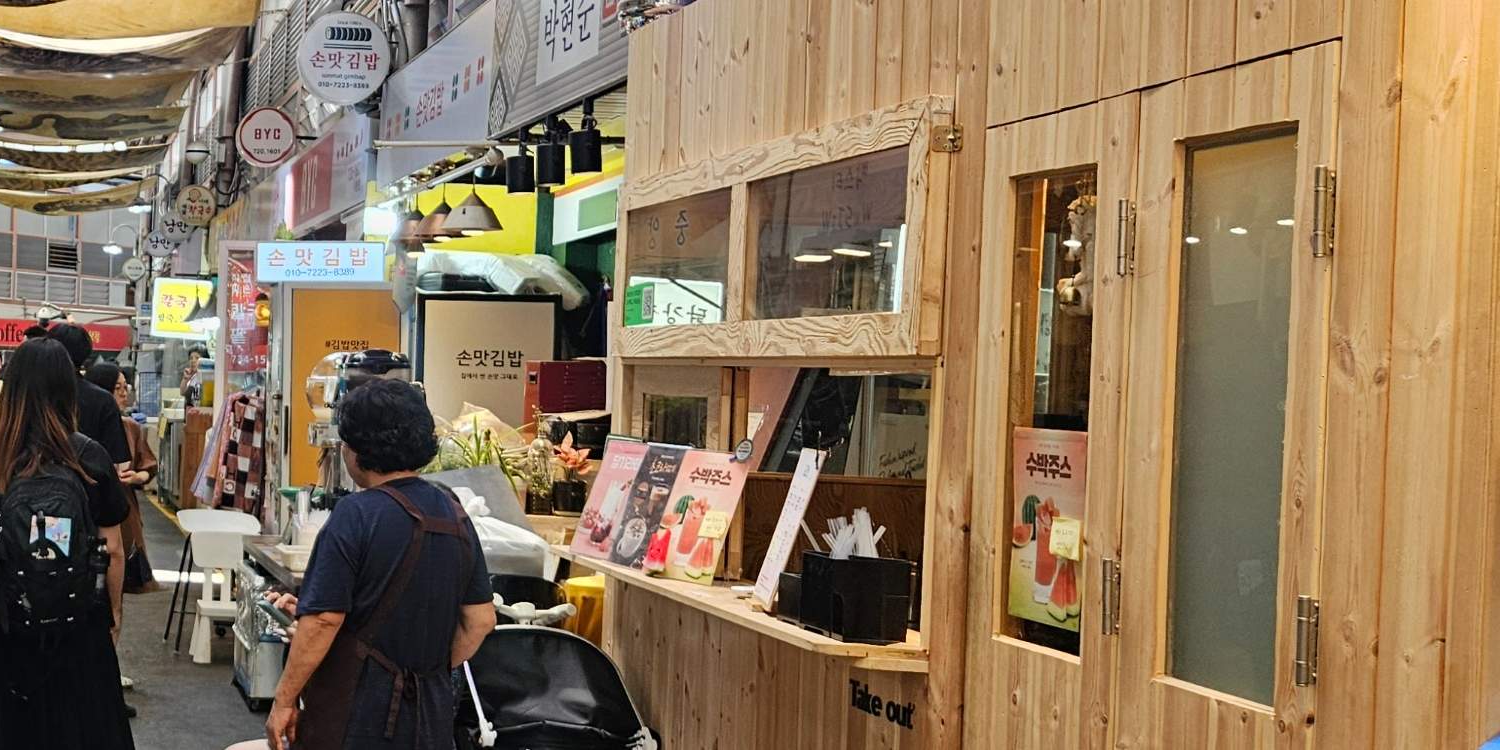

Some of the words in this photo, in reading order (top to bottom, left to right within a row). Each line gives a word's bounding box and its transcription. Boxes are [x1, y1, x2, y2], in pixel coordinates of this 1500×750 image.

[309, 51, 380, 71] 손맛김밥
[254, 128, 281, 140] BYC
[267, 248, 368, 266] 손맛김밥
[285, 268, 355, 277] 010-7223-8389
[456, 350, 524, 367] 손맛김밥
[1026, 452, 1071, 479] 수박주스
[689, 467, 732, 486] 수박주스
[849, 678, 882, 716] Take
[886, 701, 916, 730] out
